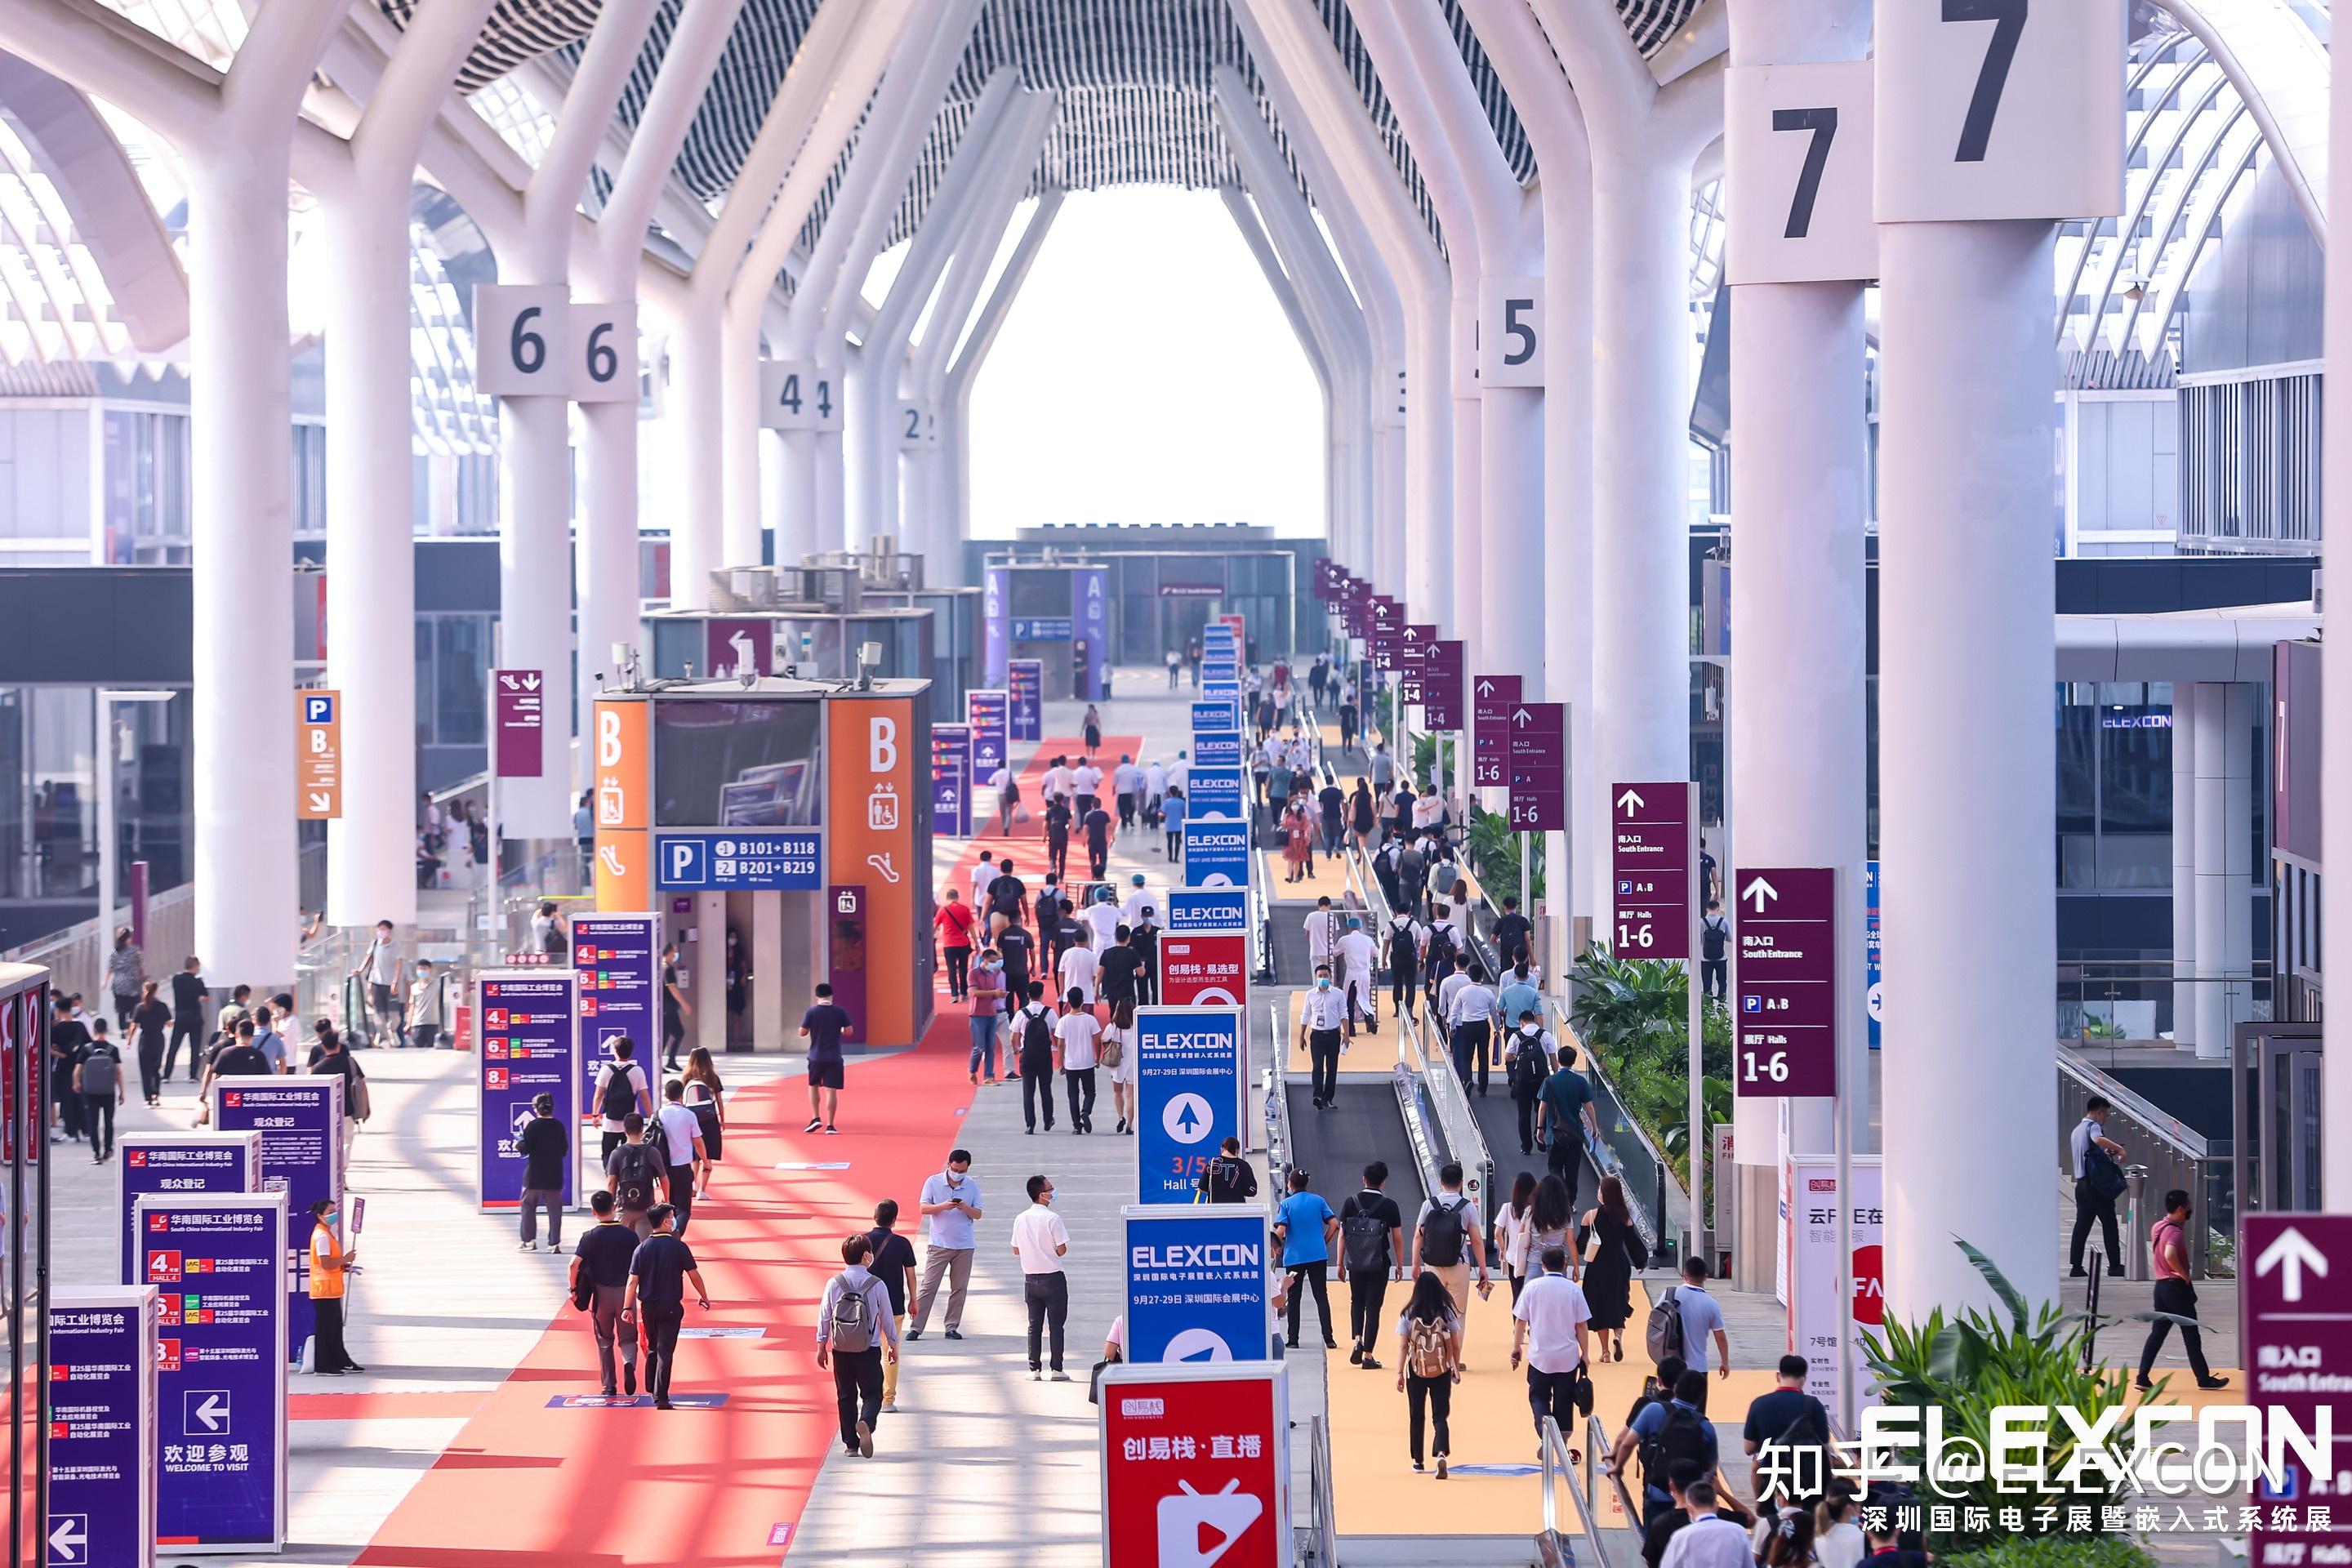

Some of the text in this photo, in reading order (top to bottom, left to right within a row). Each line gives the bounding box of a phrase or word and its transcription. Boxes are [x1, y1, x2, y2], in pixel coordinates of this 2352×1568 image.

[1941, 0, 2028, 162] 7
[1773, 108, 1838, 238] 7
[1504, 299, 1536, 365] 5
[511, 307, 546, 374] 6
[588, 323, 617, 382] 6
[780, 374, 802, 414] 4
[905, 409, 920, 439] 2
[988, 573, 999, 595] A
[1087, 576, 1101, 598] A
[1376, 657, 1391, 668] 1-4
[1404, 689, 1420, 701] 1-4
[310, 700, 327, 719] P
[1428, 713, 1445, 725] 1-4
[2102, 715, 2172, 728] ELEXCON
[311, 729, 327, 753] B
[599, 710, 622, 766] B
[870, 717, 898, 773] B
[1196, 742, 1239, 751] ELEXCON
[1477, 765, 1499, 781] 1-6
[1190, 779, 1239, 788] ELEXCON
[1513, 806, 1539, 823] 1-6
[1187, 835, 1245, 846] ELEXCON
[1618, 835, 1642, 844] 南入口
[739, 842, 773, 855] B101
[783, 842, 815, 855] B118
[673, 845, 693, 879] P
[739, 862, 773, 874] B201
[782, 862, 815, 874] B219
[1621, 883, 1628, 892] P
[1172, 906, 1242, 920] ELEXCON
[1618, 924, 1654, 948] 1-6
[1743, 936, 1774, 947] 南入口
[578, 947, 588, 959] 4
[1743, 950, 1803, 959] South Entrance
[1169, 964, 1239, 975] 创易栈·易选型
[580, 973, 589, 984] 6
[1747, 998, 1757, 1009] P
[488, 1010, 499, 1023] 4
[488, 1040, 499, 1053] 6
[1142, 1032, 1232, 1050] ELEXCON
[1744, 1035, 1788, 1045] 展厅 Halls
[1143, 1067, 1233, 1076] 9月27-29日 深圳国际会展中心
[1743, 1051, 1789, 1082] 1-6
[488, 1070, 500, 1084] 8
[254, 1117, 295, 1127] 观众登记
[149, 1151, 233, 1161] 华南国际工业博览会
[160, 1178, 205, 1189] 观众登记
[1164, 1178, 1187, 1190] Hall
[171, 1214, 263, 1224] 华南国际工业博览会
[151, 1254, 167, 1272] 4
[1133, 1245, 1258, 1268] ELEXCON
[1134, 1272, 1258, 1281] 深圳国际电子展暨嵌入式系统展
[1134, 1294, 1259, 1305] 9月27-29日 深圳国际会展中心
[1810, 1337, 1837, 1348] 7号馆
[164, 1444, 248, 1462] 欢迎参观
[1123, 1435, 1262, 1461] 创易栈·直播
[166, 1463, 249, 1472] WELCOME TO VISIT
